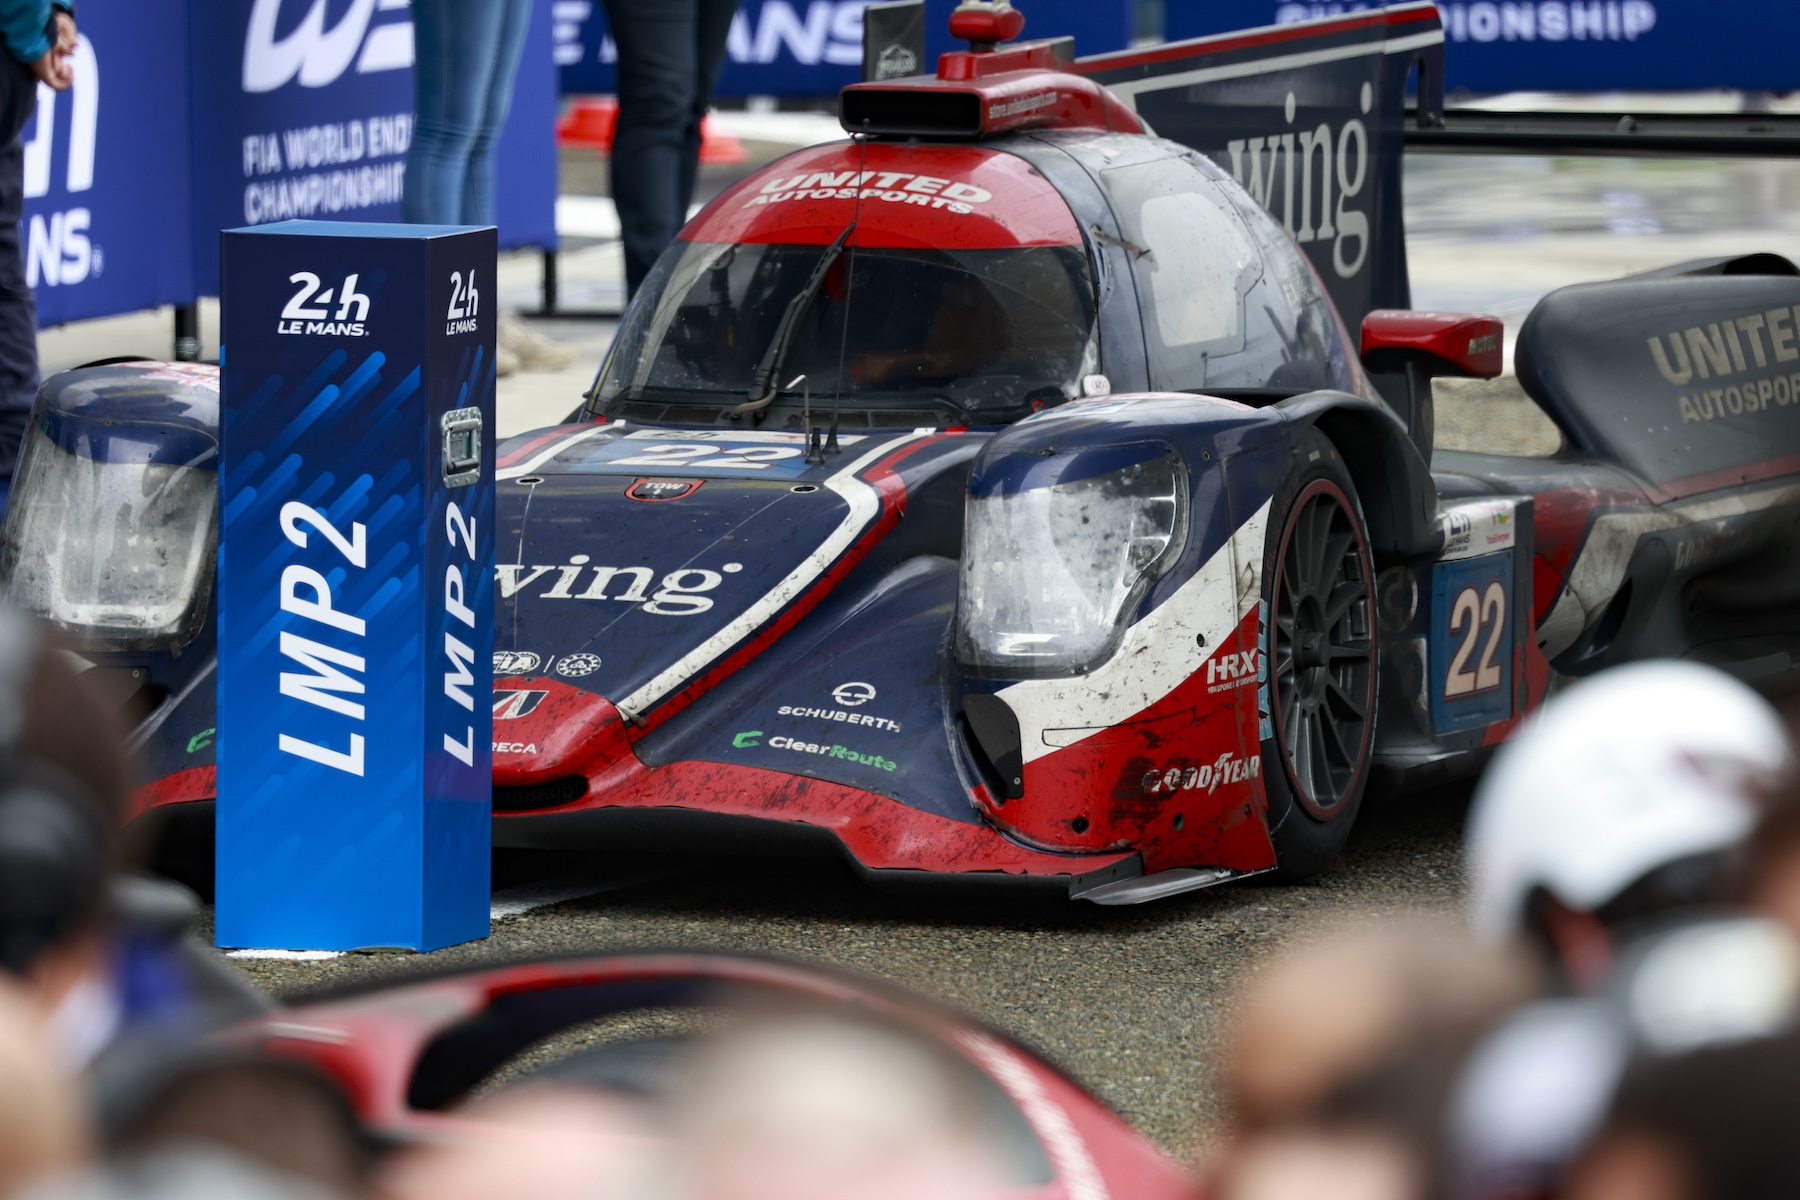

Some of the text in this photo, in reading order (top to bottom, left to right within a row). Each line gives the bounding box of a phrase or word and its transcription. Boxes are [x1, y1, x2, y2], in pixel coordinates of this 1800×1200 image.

[242, 113, 415, 177] FIA WORLD END
[760, 171, 993, 204] UNITED
[1228, 80, 1374, 278] wing
[742, 188, 974, 215] AUTOSPORTS
[281, 271, 371, 321] 24h
[447, 268, 479, 320] 24h
[277, 320, 366, 337] LE MANS
[446, 318, 477, 336] LE MANS
[1647, 304, 1800, 386] UNITE
[607, 444, 805, 470] 22
[645, 482, 685, 490] TOW
[279, 501, 366, 777] LMP2
[444, 502, 476, 767] LMP2
[1444, 577, 1506, 700] 22
[1206, 648, 1258, 685] HRX
[777, 705, 903, 733] SCHUBERTH
[768, 736, 897, 772] ClearRoute
[1142, 752, 1261, 796] GOODYEAR
